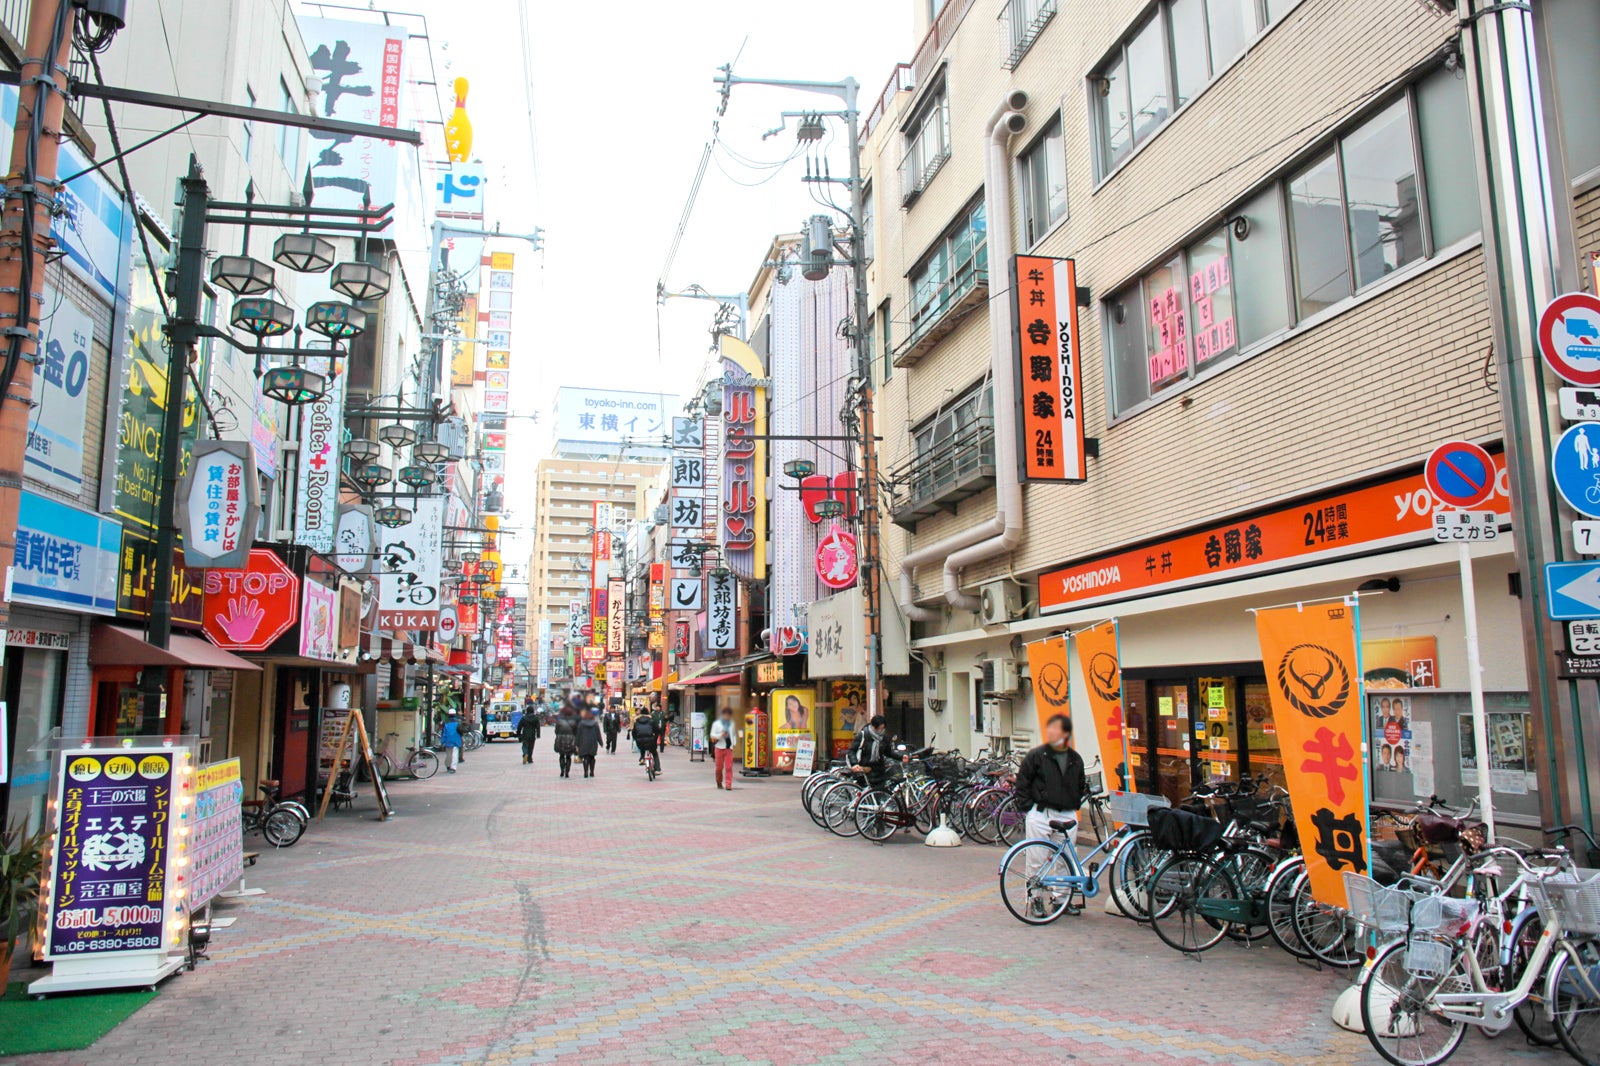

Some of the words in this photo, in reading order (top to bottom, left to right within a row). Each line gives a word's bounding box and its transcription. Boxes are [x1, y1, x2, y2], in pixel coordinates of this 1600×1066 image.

[382, 42, 400, 138] 韓国家庭料理・焼
[1028, 268, 1046, 307] 牛丼
[585, 398, 657, 411] toyoko-inn.com
[578, 412, 663, 433] 東横イン
[1035, 430, 1053, 448] 24
[204, 465, 225, 543] 賃住の賃貸
[222, 463, 242, 551] お部屋さがしは
[305, 471, 328, 531] Room
[1325, 503, 1347, 522] 時間
[1303, 510, 1325, 547] 24
[1435, 514, 1496, 524] 自動車
[1325, 522, 1349, 541] 営業
[1436, 526, 1497, 539] ここから
[1580, 528, 1592, 546] 7
[14, 529, 76, 579] 賃貸住宅
[73, 544, 82, 581] サービス
[1145, 550, 1173, 577] 牛丼
[133, 553, 203, 605] 上カレー
[205, 572, 290, 595] STOP
[1414, 662, 1433, 686] 牛
[1566, 658, 1600, 668] 十三サカエ
[109, 762, 132, 776] 安心
[89, 788, 147, 805] 十三の穴場
[1300, 726, 1367, 874] 牛丼
[85, 815, 148, 832] エステ
[59, 787, 84, 908] 全身オイルマッサージ
[146, 785, 169, 902] シャワールーム完備
[80, 881, 142, 898] 完全個室
[56, 908, 103, 930] お試し
[104, 904, 162, 928] 5,000円
